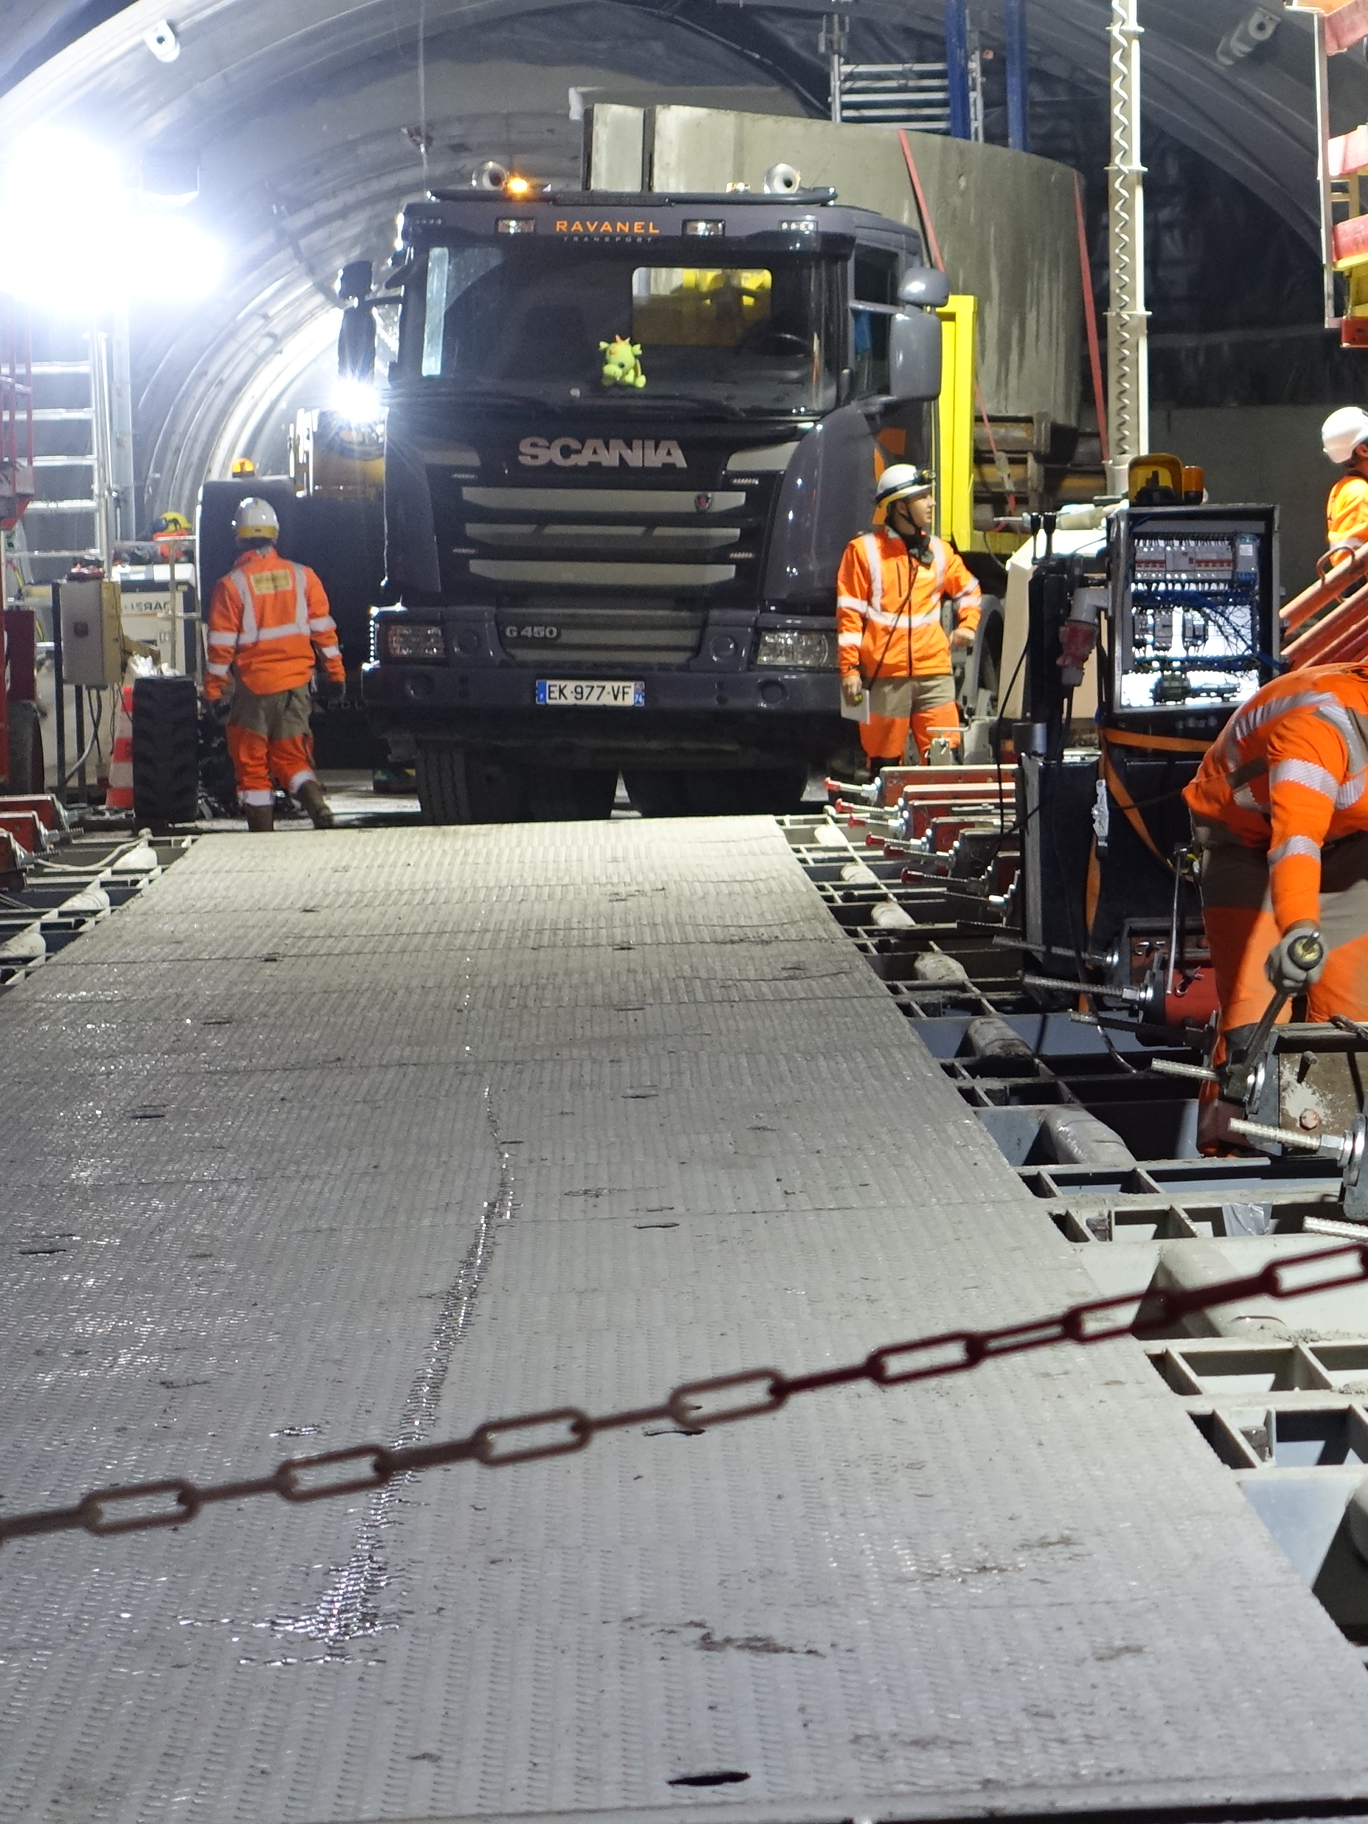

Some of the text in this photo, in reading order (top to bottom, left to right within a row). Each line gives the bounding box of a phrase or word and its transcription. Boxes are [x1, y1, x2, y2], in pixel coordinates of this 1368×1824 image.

[555, 220, 660, 234] RAVANEL
[563, 235, 652, 243] TRANSPORT
[518, 436, 688, 469] SCANIA
[505, 626, 558, 638] G 450
[547, 684, 632, 701] EK-977-VF
